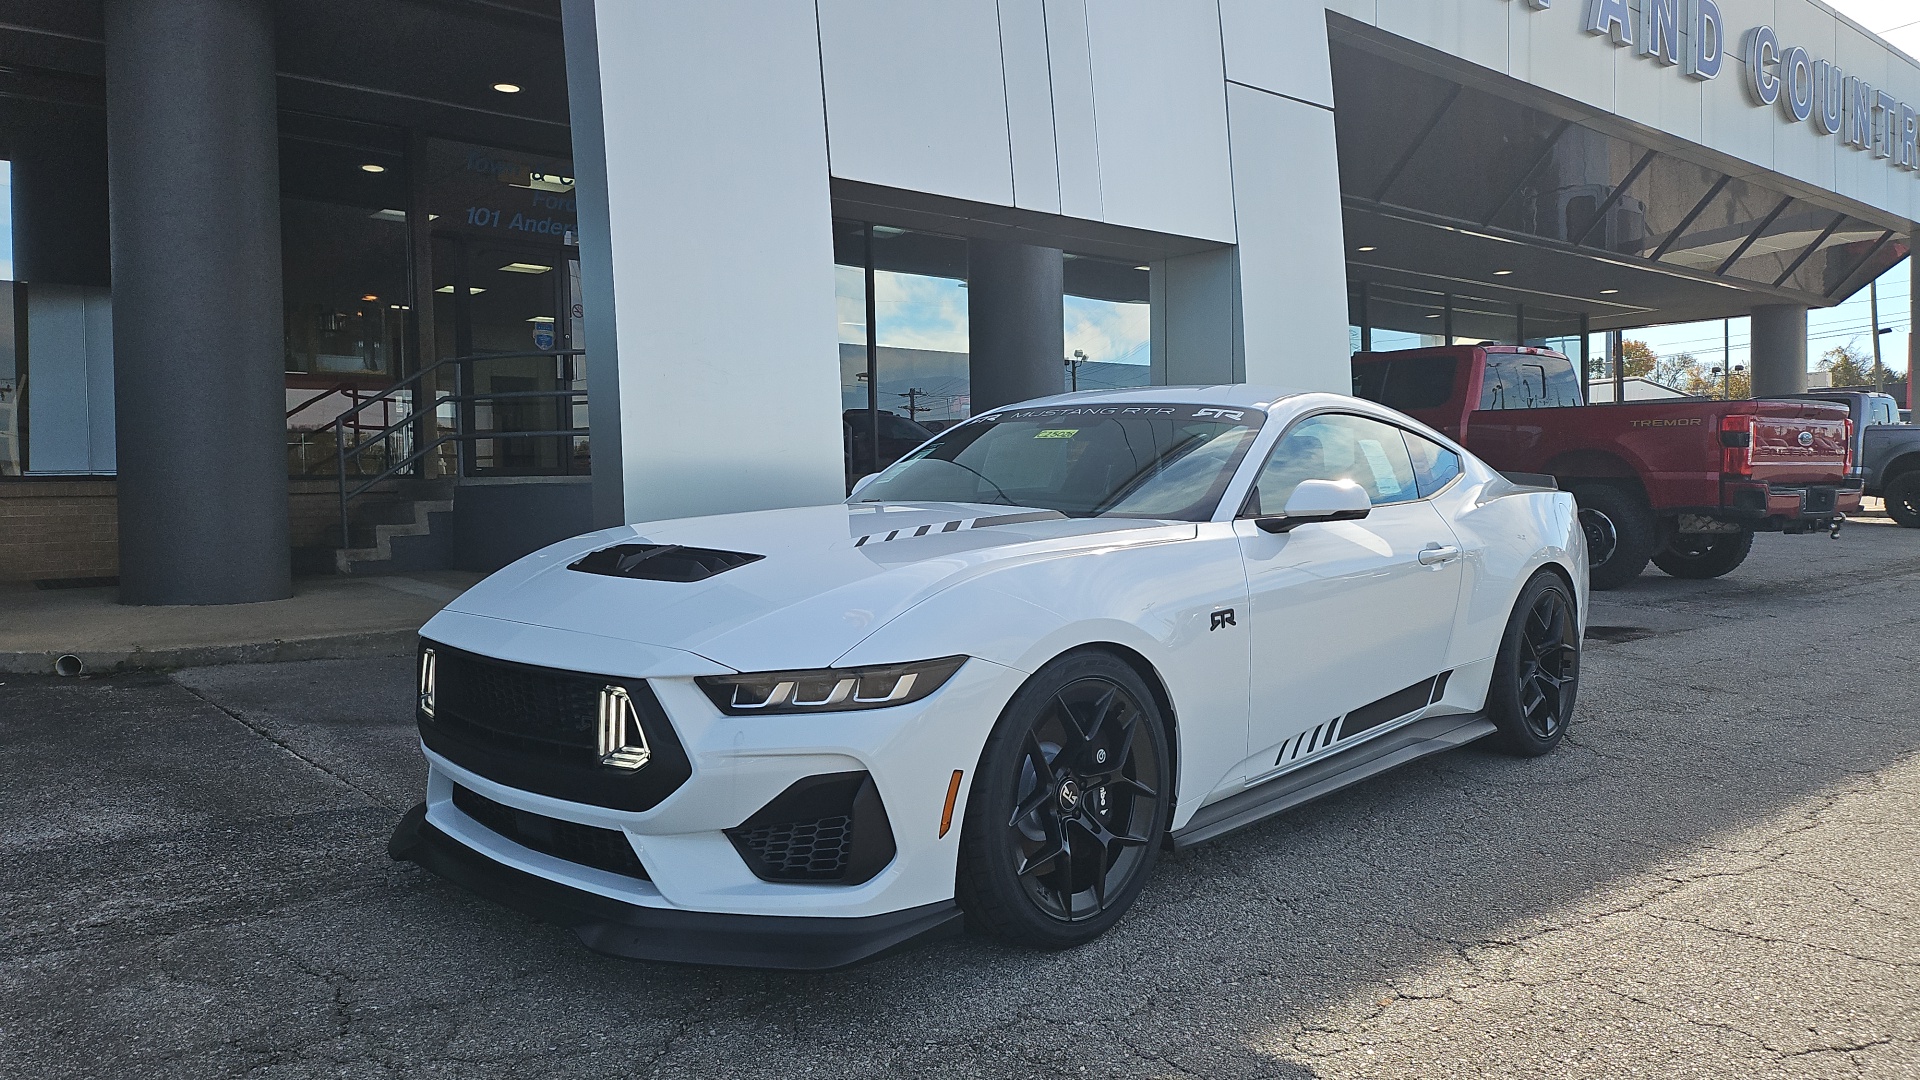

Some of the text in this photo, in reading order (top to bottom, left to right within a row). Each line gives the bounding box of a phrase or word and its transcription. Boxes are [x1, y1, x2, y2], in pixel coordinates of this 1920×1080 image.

[1588, 0, 1920, 172] AND COUNTR
[466, 206, 500, 228] 101
[1010, 406, 1176, 419] MUSTANG RTR
[1630, 418, 1702, 427] TREMOR
